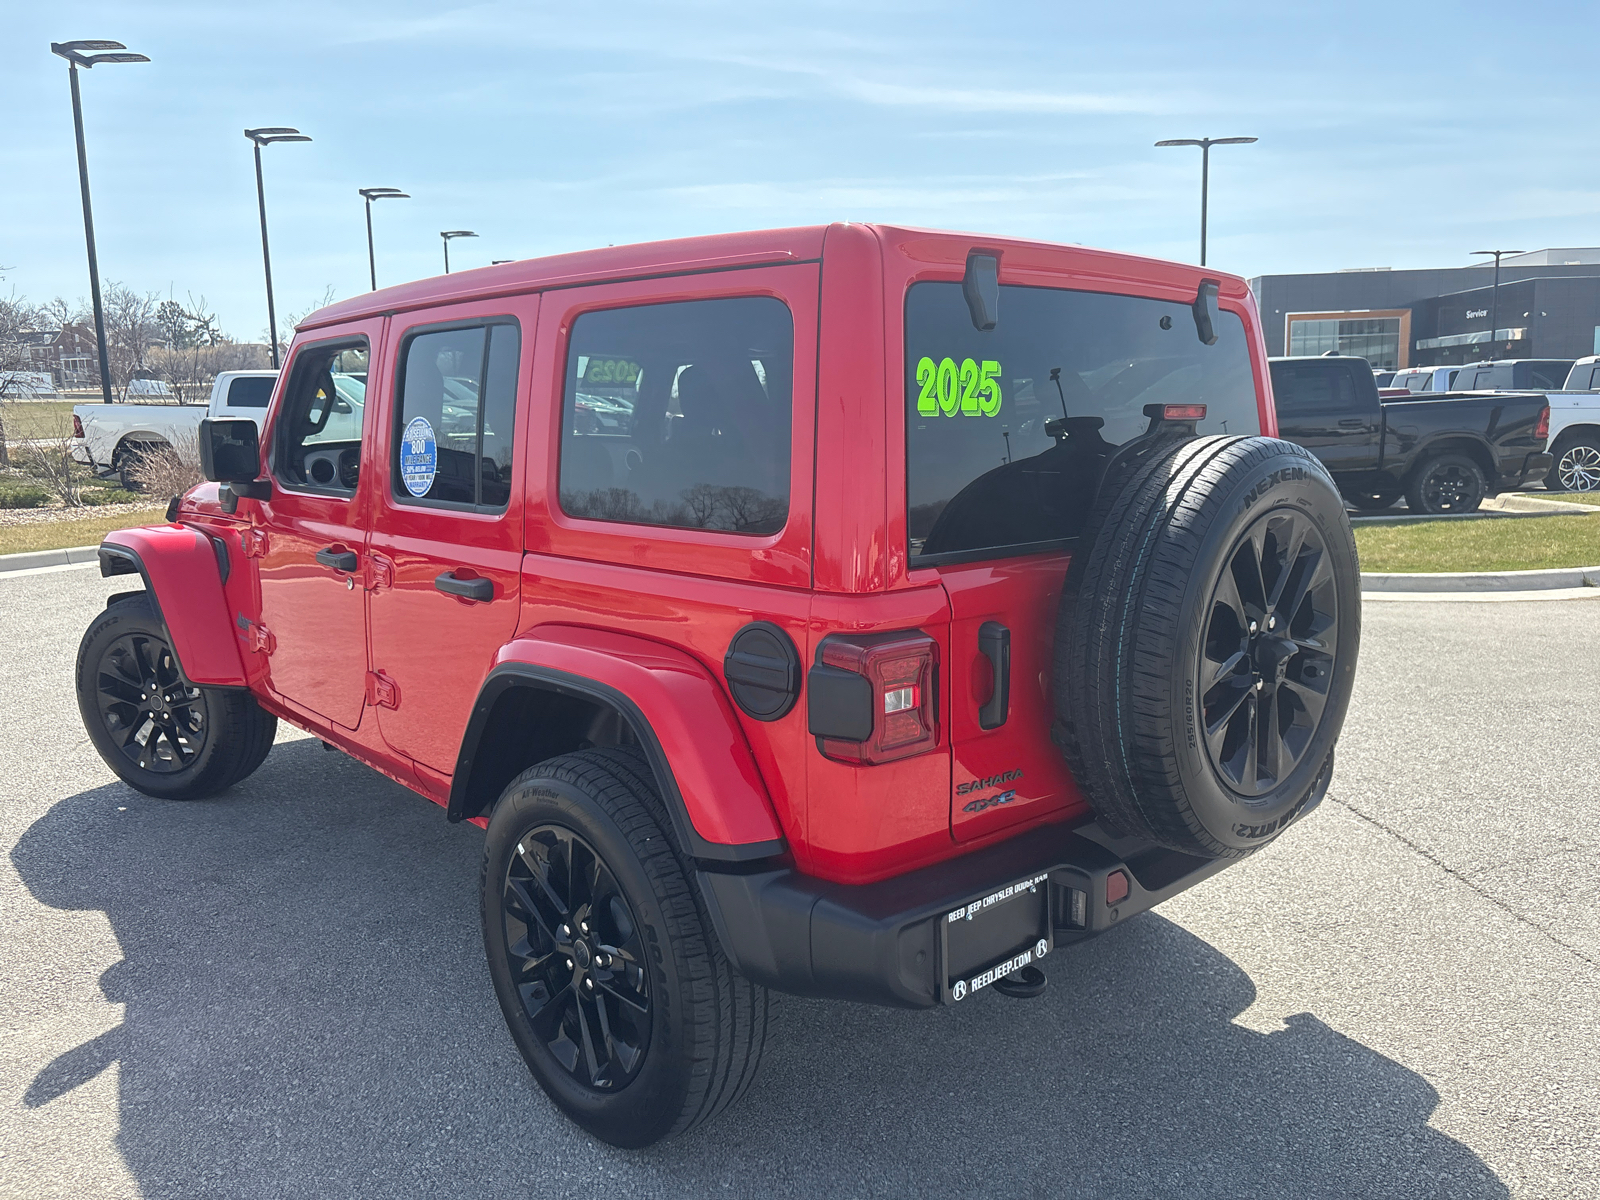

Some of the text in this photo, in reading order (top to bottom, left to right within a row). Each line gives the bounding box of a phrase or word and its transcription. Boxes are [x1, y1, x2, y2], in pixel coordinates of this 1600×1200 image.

[1466, 309, 1488, 319] Service
[916, 356, 1003, 418] 2025
[405, 454, 432, 465] MILE RANGE
[411, 439, 425, 455] 800
[1243, 466, 1303, 510] NEXEN
[1185, 678, 1196, 750] 255/60R20
[521, 787, 560, 800] All-Weather
[956, 768, 1024, 796] SAHARA
[948, 907, 965, 923] REED
[967, 900, 982, 915] JEEP
[982, 886, 1014, 908] CHRYSLER
[971, 950, 1031, 993] REEDJEEP.COM
